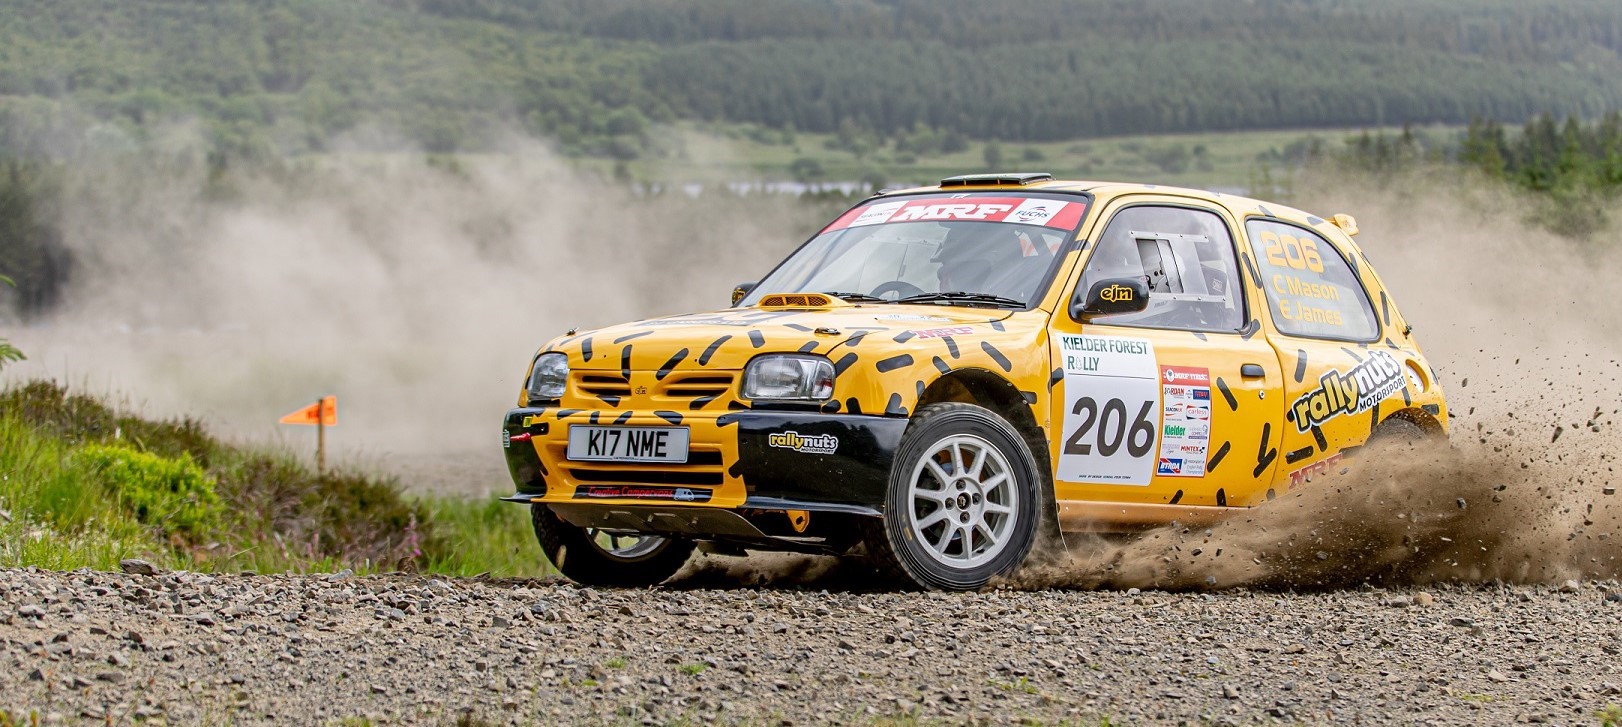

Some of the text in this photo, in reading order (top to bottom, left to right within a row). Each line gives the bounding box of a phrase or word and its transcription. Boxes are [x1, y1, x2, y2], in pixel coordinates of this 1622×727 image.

[892, 203, 1013, 220] MRF
[1015, 209, 1050, 218] FUCHS
[1261, 231, 1324, 273] 206
[1100, 285, 1133, 303] ejm
[1272, 273, 1340, 302] C Mason
[1279, 299, 1343, 326] E James
[914, 327, 974, 339] MRF
[1062, 336, 1148, 355] KIELDER FOREST
[1293, 349, 1401, 430] rallynuts
[1358, 375, 1406, 412] MOTORSPORT
[1063, 396, 1155, 458] 206
[1164, 425, 1186, 437] Kielder
[588, 429, 669, 457] K17 NME
[770, 433, 836, 449] rallynuts
[1288, 453, 1343, 491] MRF
[588, 487, 673, 498] Creative Campervans
